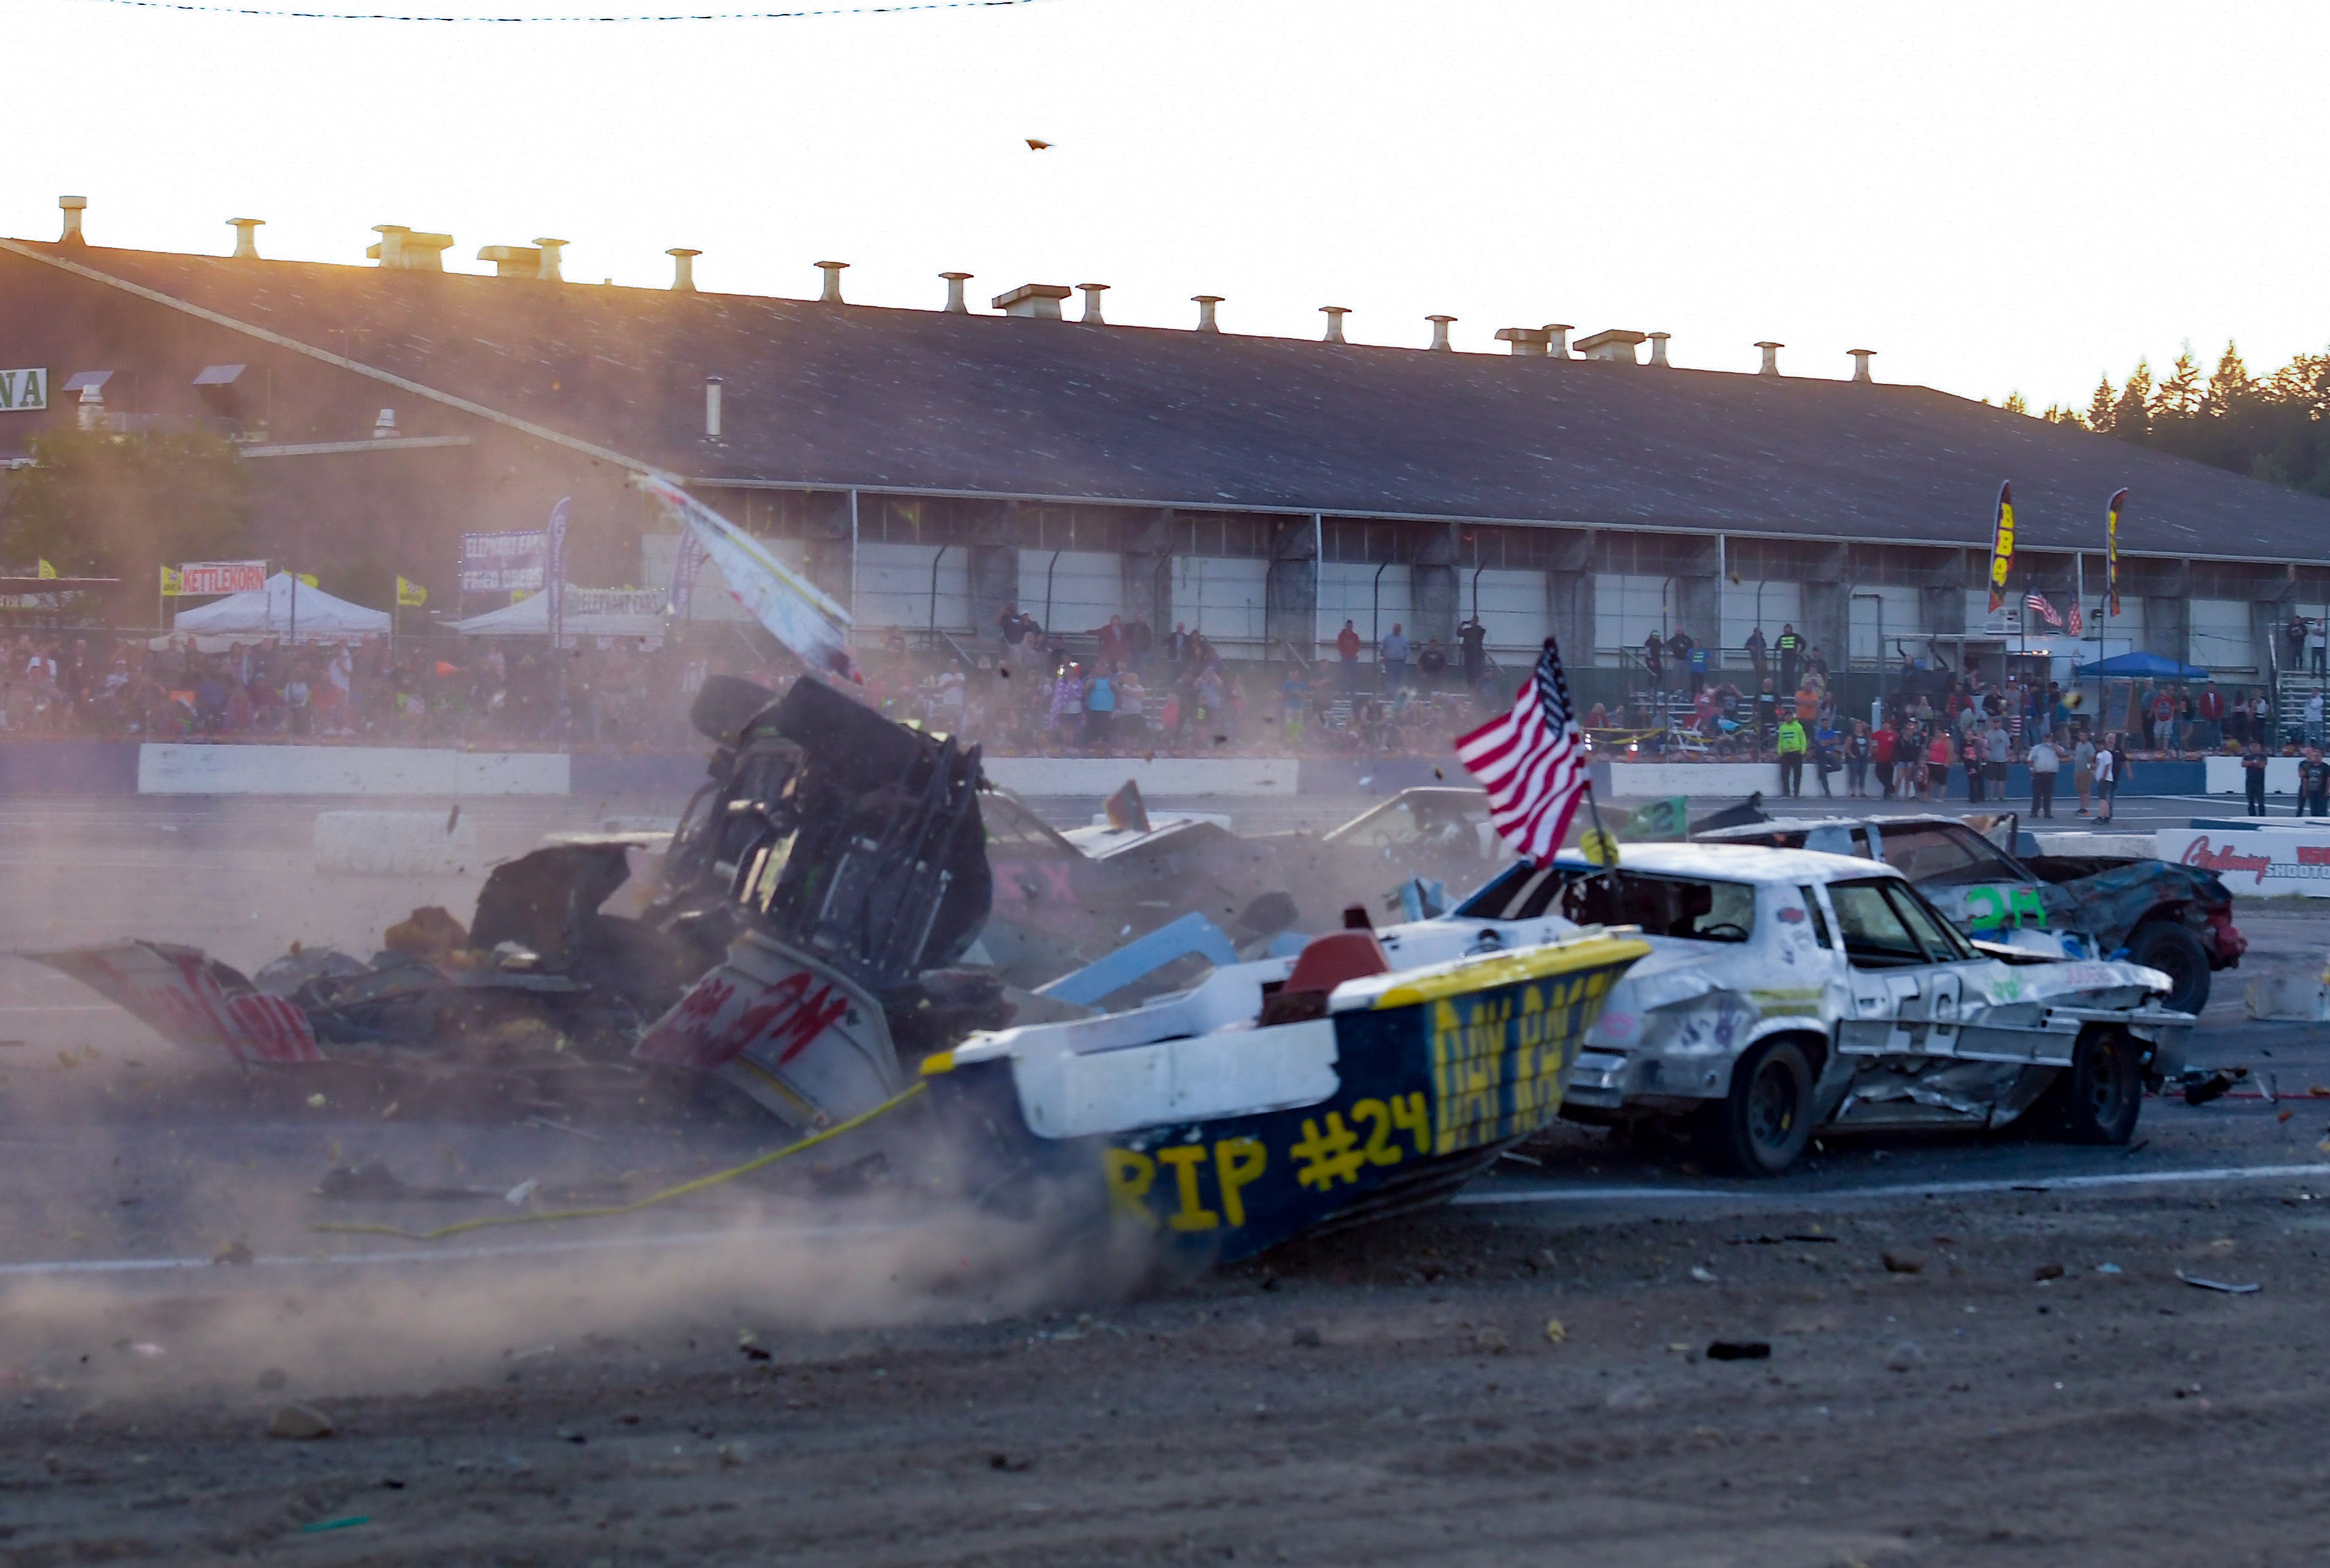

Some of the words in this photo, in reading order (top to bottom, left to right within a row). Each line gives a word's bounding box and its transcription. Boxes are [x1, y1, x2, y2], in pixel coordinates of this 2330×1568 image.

[183, 566, 265, 592] KETTLEKORN
[1105, 1136, 1268, 1232] RIP
[1289, 1091, 1431, 1192] #24
